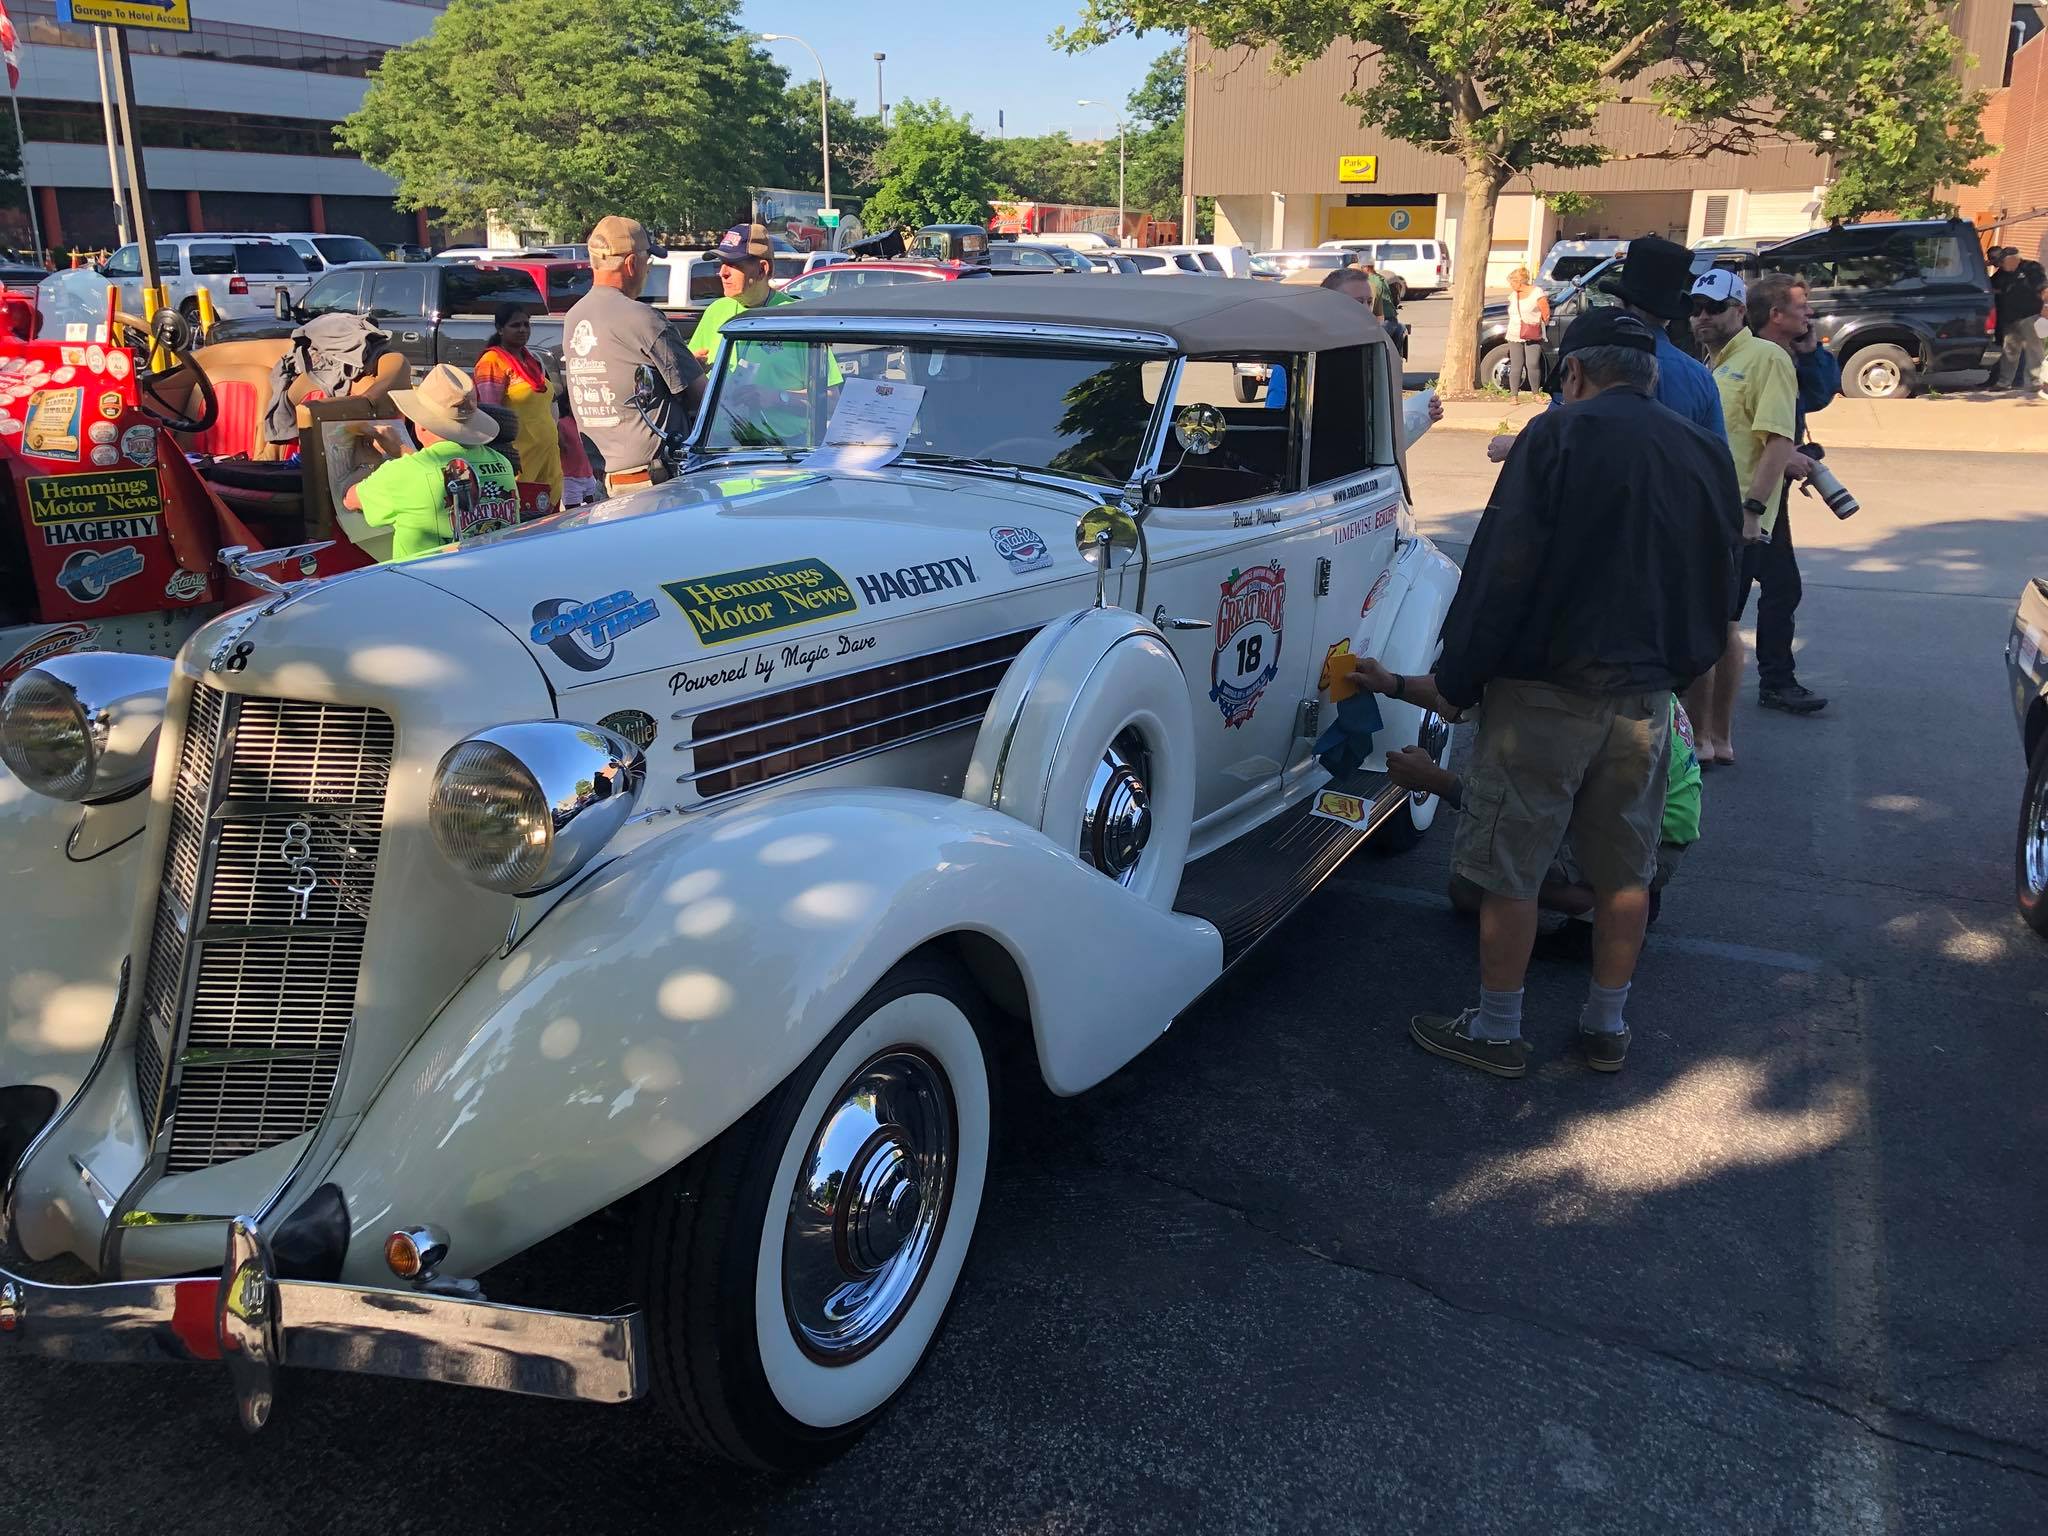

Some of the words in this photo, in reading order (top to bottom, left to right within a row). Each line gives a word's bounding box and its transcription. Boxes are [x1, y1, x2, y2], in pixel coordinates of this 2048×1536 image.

[74, 4, 112, 19] Garage
[115, 8, 126, 18] To
[129, 10, 153, 21] Hotel
[156, 11, 186, 24] Access
[1344, 159, 1363, 167] Park
[1394, 213, 1406, 230] P
[34, 500, 97, 517] Motor
[107, 495, 158, 511] News
[40, 478, 148, 499] Hemmings
[46, 516, 155, 545] HAGERTY
[1233, 510, 1253, 528] Brad
[1256, 508, 1281, 528] Phillips
[682, 567, 824, 605] Hemmings
[856, 556, 978, 605] HAGERTY
[530, 590, 639, 645] COKER
[582, 598, 660, 648] TIRE
[688, 601, 775, 634] Motor
[778, 585, 850, 614] News
[1216, 591, 1259, 650] GREAT
[1258, 583, 1285, 632] RACE
[22, 632, 95, 664] RELIABLE
[668, 657, 748, 696] Powered
[754, 653, 775, 683] by
[781, 645, 830, 673] Magic
[836, 635, 877, 656] Dave
[1237, 634, 1263, 676] 18
